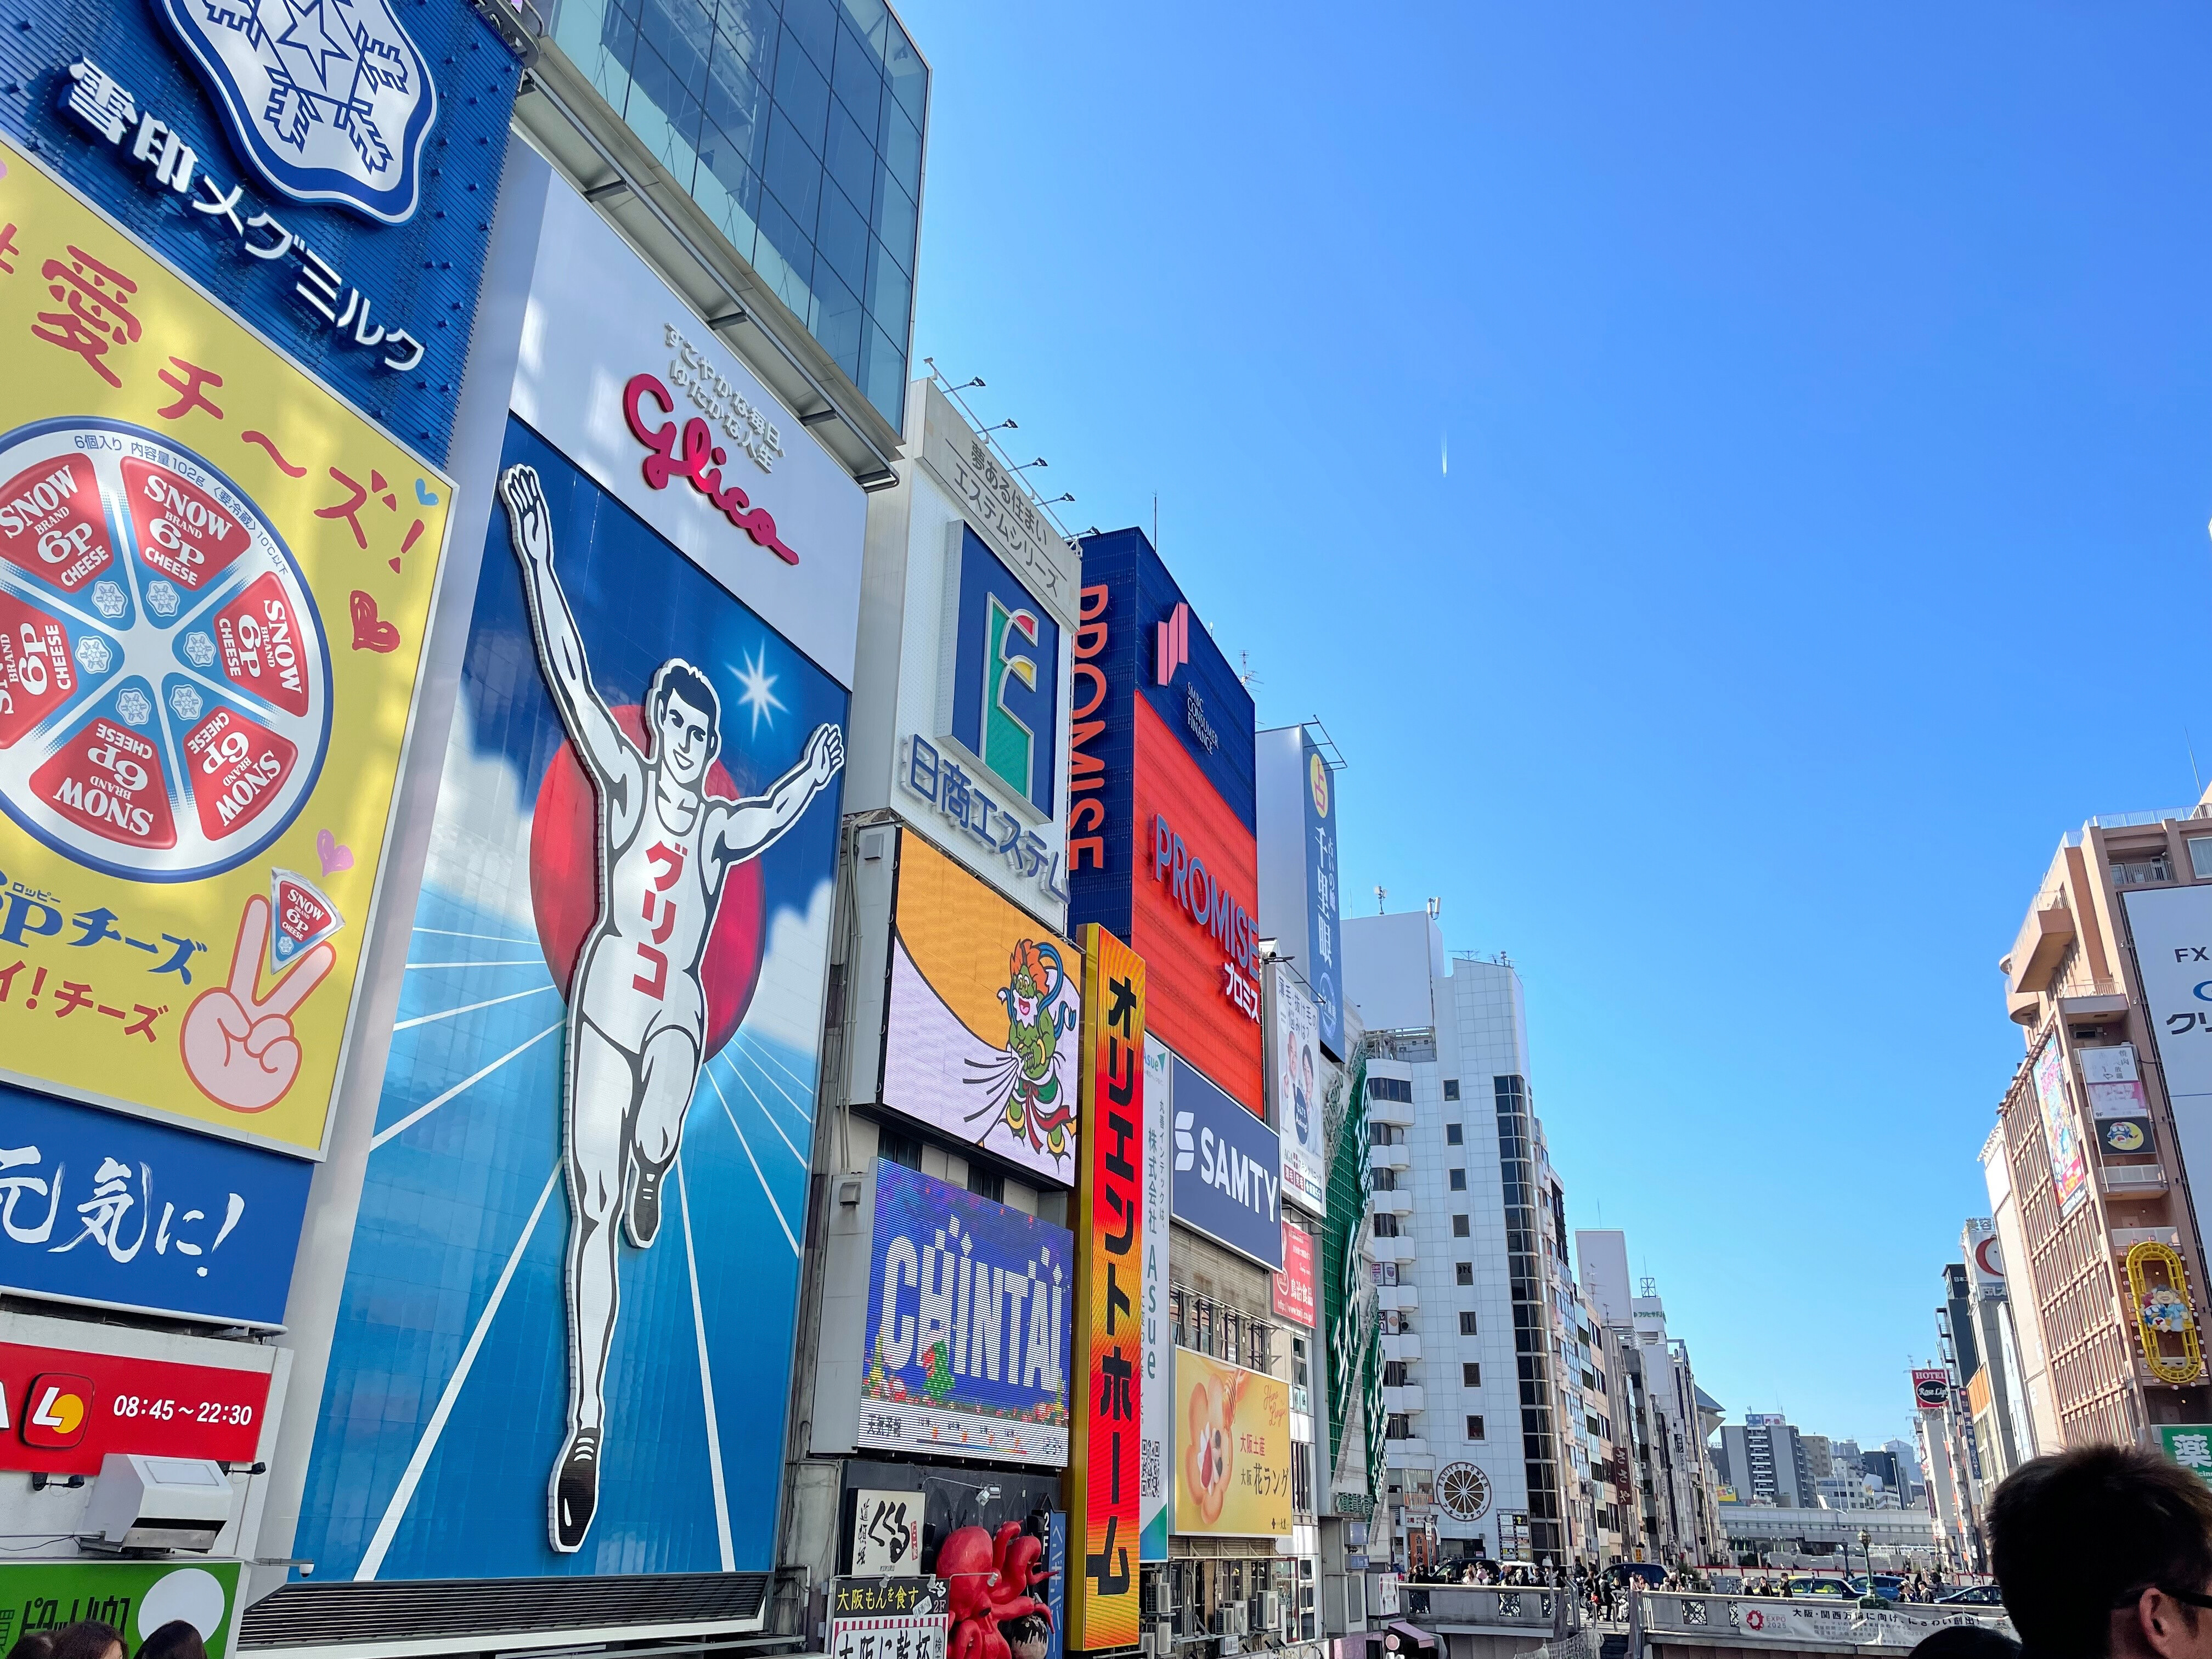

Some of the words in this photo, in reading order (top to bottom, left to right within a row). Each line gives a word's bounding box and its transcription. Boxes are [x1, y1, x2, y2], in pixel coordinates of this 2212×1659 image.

[67, 54, 425, 372] 雪印メグミルク
[669, 358, 773, 474] ゆたかな人生
[74, 434, 123, 452] 6個入り
[130, 441, 207, 487] 内容量102g
[623, 373, 799, 566] Glico
[1, 464, 79, 539] SNOW
[144, 474, 232, 541] SNOW
[971, 440, 1047, 545] 夢ある住まい
[35, 506, 70, 536] BRAND
[37, 522, 93, 565] 6P
[150, 518, 205, 567] 6P
[165, 511, 202, 539] BRAND
[954, 462, 1058, 598] エステムシリーズ
[60, 545, 109, 588] CHEESE
[144, 546, 198, 586] CHEESE
[18, 622, 48, 696] 6P
[44, 624, 72, 690] CHEESE
[218, 618, 241, 677] CHEESE
[237, 614, 262, 679] 6P
[261, 625, 275, 668] BRAND
[264, 599, 302, 694] SNOW
[1188, 682, 1204, 713] SMBC
[95, 723, 152, 759] CHEESE
[189, 712, 230, 754] CHEESE
[1187, 697, 1219, 749] CONSUMER
[1187, 711, 1213, 755] FINANCE
[88, 743, 149, 791] 6P
[201, 730, 249, 775] 6P
[223, 758, 253, 785] BRAND
[53, 776, 154, 836] SNOW
[89, 775, 132, 799] BRAND
[215, 749, 281, 827] SNOW
[909, 733, 1071, 905] 日商エステム
[12, 882, 61, 904] ロッピー
[287, 889, 325, 922] SNOW
[294, 906, 311, 920] BRAND
[1154, 813, 1259, 981] PROMISE
[0, 870, 207, 985] Pチーズ
[281, 921, 305, 941] CHEESE
[286, 908, 309, 932] 6P
[633, 840, 688, 1002] グリコ
[2174, 946, 2210, 963] FX
[1222, 961, 1261, 1025] プロミス
[1148, 1127, 1158, 1234] 株式会社
[1201, 1126, 1278, 1223] SAMTY
[1087, 975, 1137, 1595] オリエントホーム
[881, 1229, 1063, 1392] CHINTAI
[1147, 1244, 1158, 1379] Asue
[1918, 1387, 1934, 1396] Rose
[1240, 1432, 1266, 1457] 大阪土産
[2172, 1434, 2212, 1468] 薬
[1240, 1469, 1252, 1486] 大阪
[1253, 1462, 1289, 1497] 花ラング
[1438, 1464, 1460, 1487] FRUITS
[1464, 1464, 1488, 1487] TOWER
[868, 1500, 910, 1563] くくる
[1043, 1512, 1049, 1555] 2F
[837, 1585, 919, 1611] 大阪もんを食す
[933, 1599, 946, 1613] 2F
